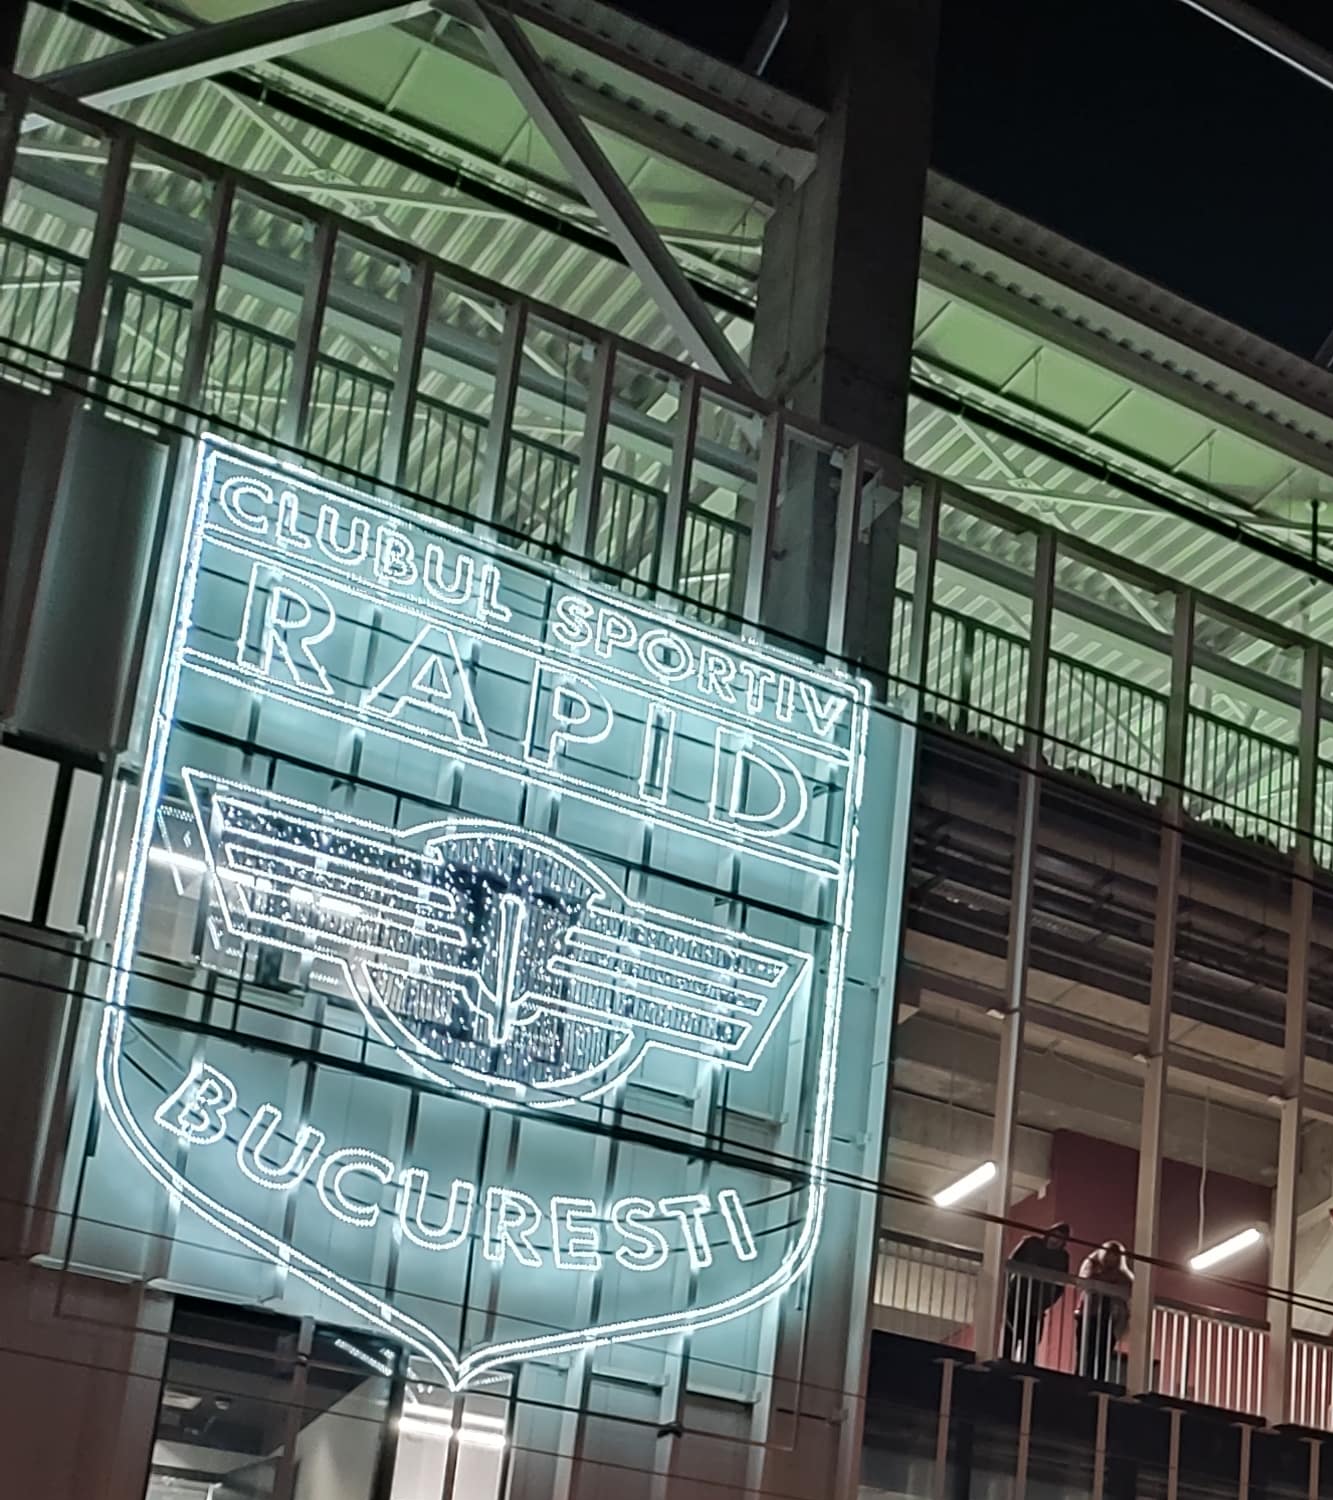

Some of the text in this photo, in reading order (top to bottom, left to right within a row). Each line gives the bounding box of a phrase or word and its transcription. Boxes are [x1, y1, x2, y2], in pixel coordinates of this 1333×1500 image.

[220, 474, 848, 738] CLUBUL SPORTIV
[236, 561, 808, 839] RAPID
[154, 1057, 757, 1271] BUCURESTI
